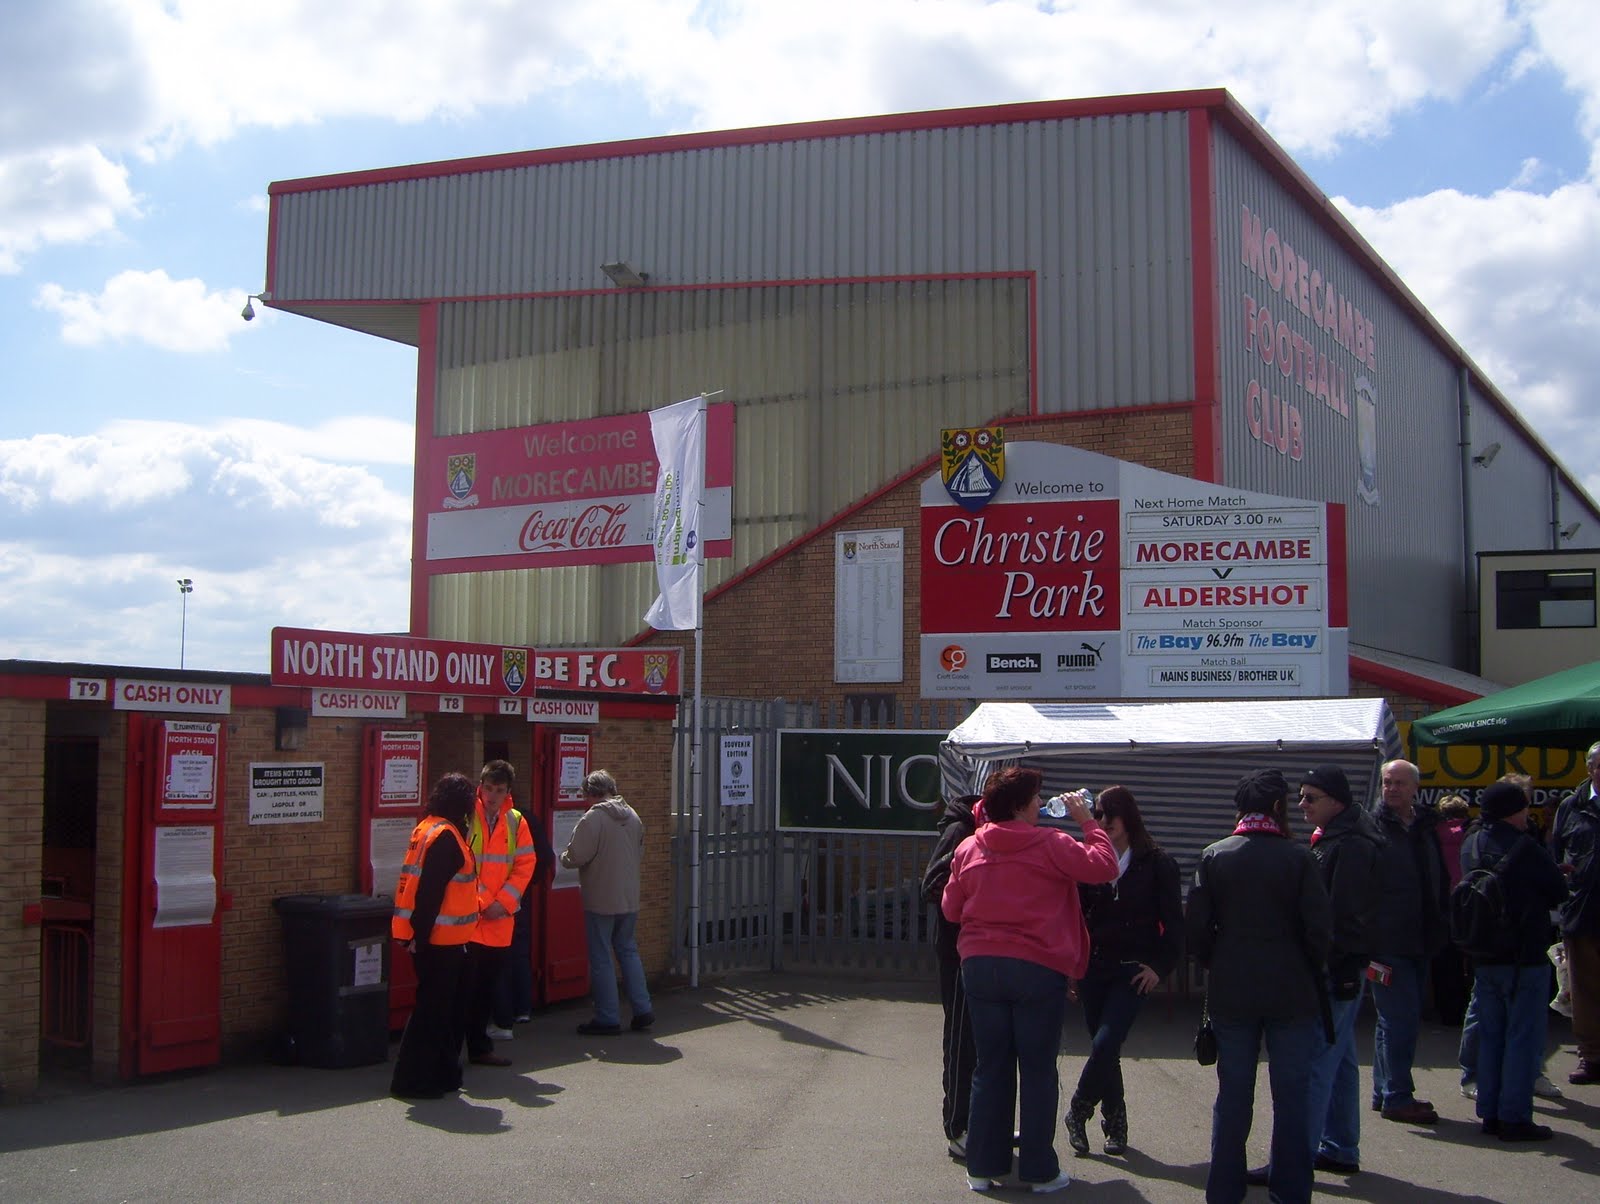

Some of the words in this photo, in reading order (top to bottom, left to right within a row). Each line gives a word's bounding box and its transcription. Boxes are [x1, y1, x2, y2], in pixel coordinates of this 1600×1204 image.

[1242, 204, 1375, 373] MORECAMBE
[1244, 294, 1349, 420] FOOTBALL
[1246, 379, 1302, 462] CLUB
[523, 428, 638, 458] Welcome
[492, 461, 654, 501] MORECAMBE
[1015, 481, 1084, 495] Welcome
[1088, 480, 1104, 493] to
[1134, 498, 1163, 509] Next
[1166, 497, 1204, 508] Home
[1207, 495, 1247, 507] Match
[518, 502, 631, 552] Coca-Cola
[1162, 515, 1230, 527] SATURDAY
[1234, 514, 1264, 526] 3.00
[1267, 516, 1282, 524] PM
[858, 542, 879, 551] North
[879, 540, 900, 550] Stand
[934, 514, 1106, 567] Christie
[1136, 540, 1311, 563] MORECAMBE
[996, 571, 1105, 619] Park
[1143, 584, 1309, 608] ALDERSHOT
[1182, 618, 1217, 628] Match
[1219, 618, 1264, 629] Sponsor
[1136, 636, 1157, 649] The
[1159, 635, 1203, 651] Bay
[1206, 634, 1244, 648] 96.9fm
[1249, 634, 1269, 647] The
[1271, 633, 1317, 649] Bay
[283, 639, 364, 678] NORTH
[372, 647, 439, 682] STAND
[446, 652, 495, 685] ONLY
[1057, 654, 1095, 667] PUMA
[1201, 657, 1228, 666] Match
[1230, 657, 1247, 666] Ball
[578, 654, 626, 687] F.C.
[1160, 671, 1189, 682] MAINS
[1191, 671, 1232, 681] BUSINESS
[1280, 670, 1294, 680] UK
[77, 682, 99, 697] T9
[123, 684, 173, 703] CASH
[176, 687, 223, 706] ONLY
[319, 693, 361, 710] CASH
[362, 695, 400, 711] ONLY
[444, 698, 460, 710] T8
[504, 700, 517, 712] T7
[533, 702, 562, 715] CASH
[565, 702, 594, 716] ONLY
[1432, 721, 1476, 736] UNTRADITIONAL
[1476, 717, 1496, 727] SINCE
[168, 736, 192, 744] NORTH
[298, 777, 321, 785] GROUND
[300, 810, 322, 819] OBJECTS
